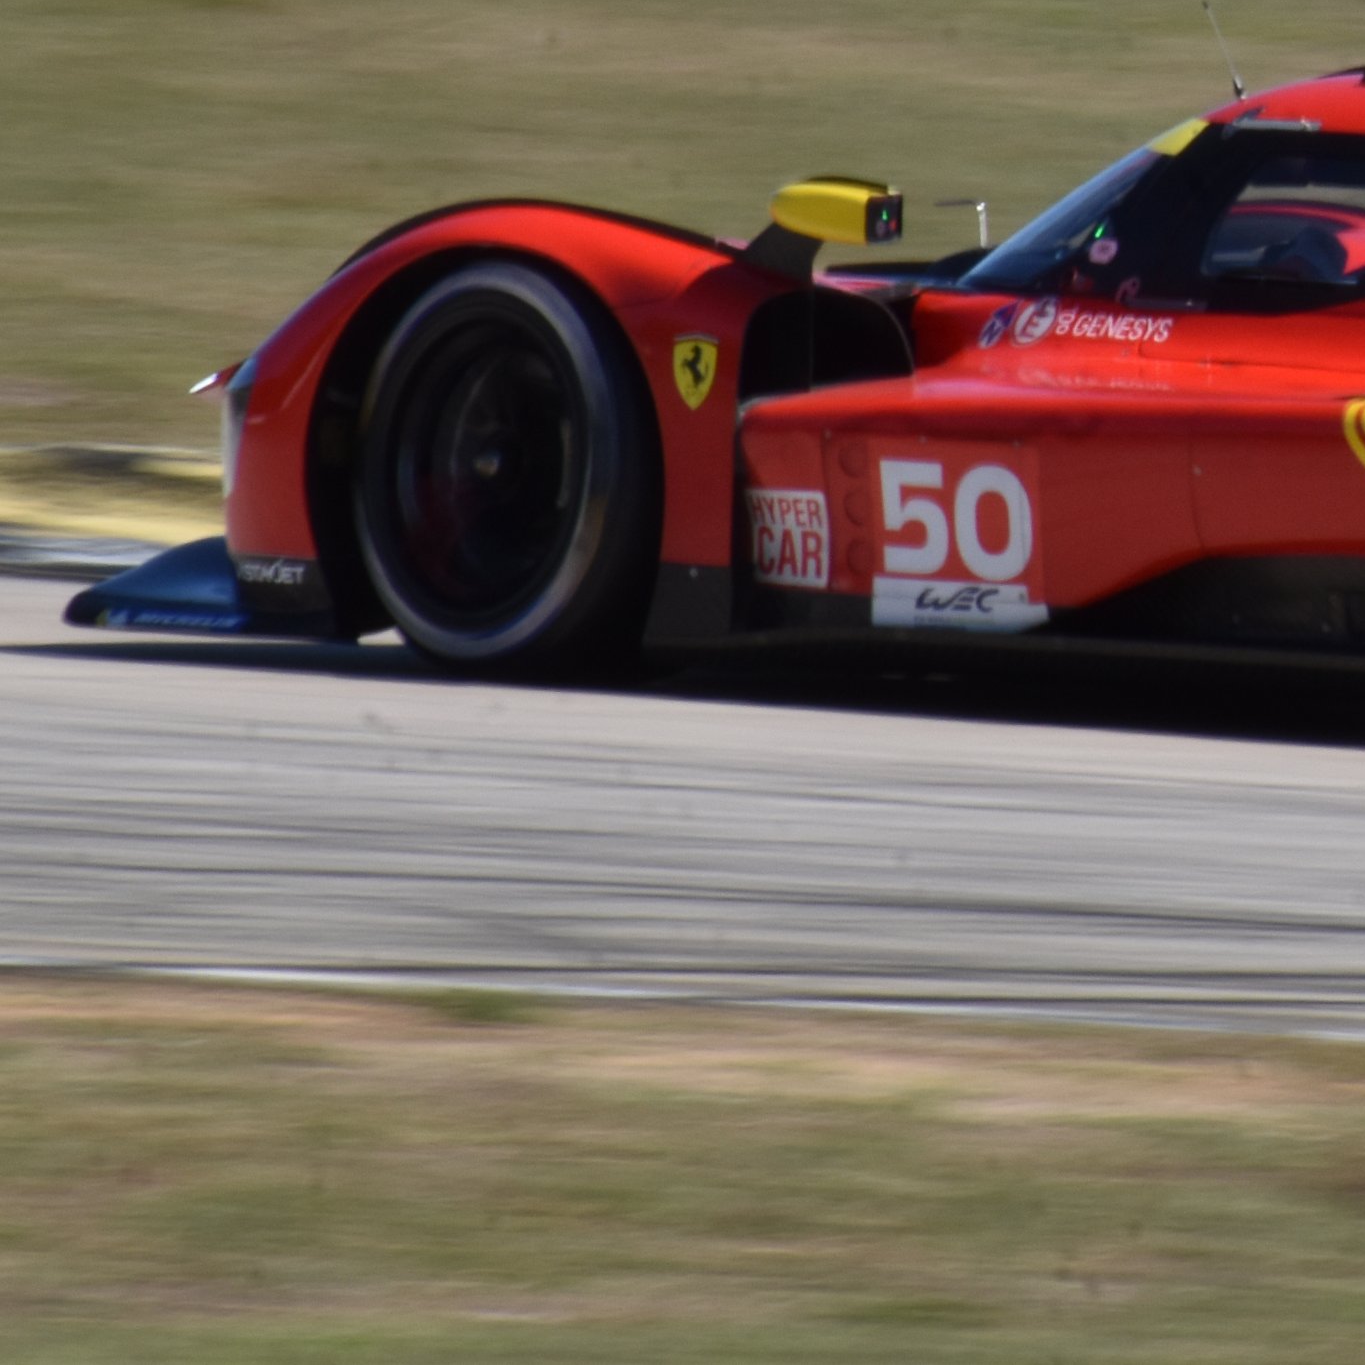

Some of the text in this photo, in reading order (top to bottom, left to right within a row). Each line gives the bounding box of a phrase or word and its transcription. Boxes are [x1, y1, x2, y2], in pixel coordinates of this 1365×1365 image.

[1073, 313, 1173, 343] GENESYS
[751, 496, 823, 529] HYPER
[878, 459, 1033, 582] 50
[757, 525, 823, 579] CAR
[915, 586, 999, 613] WEC
